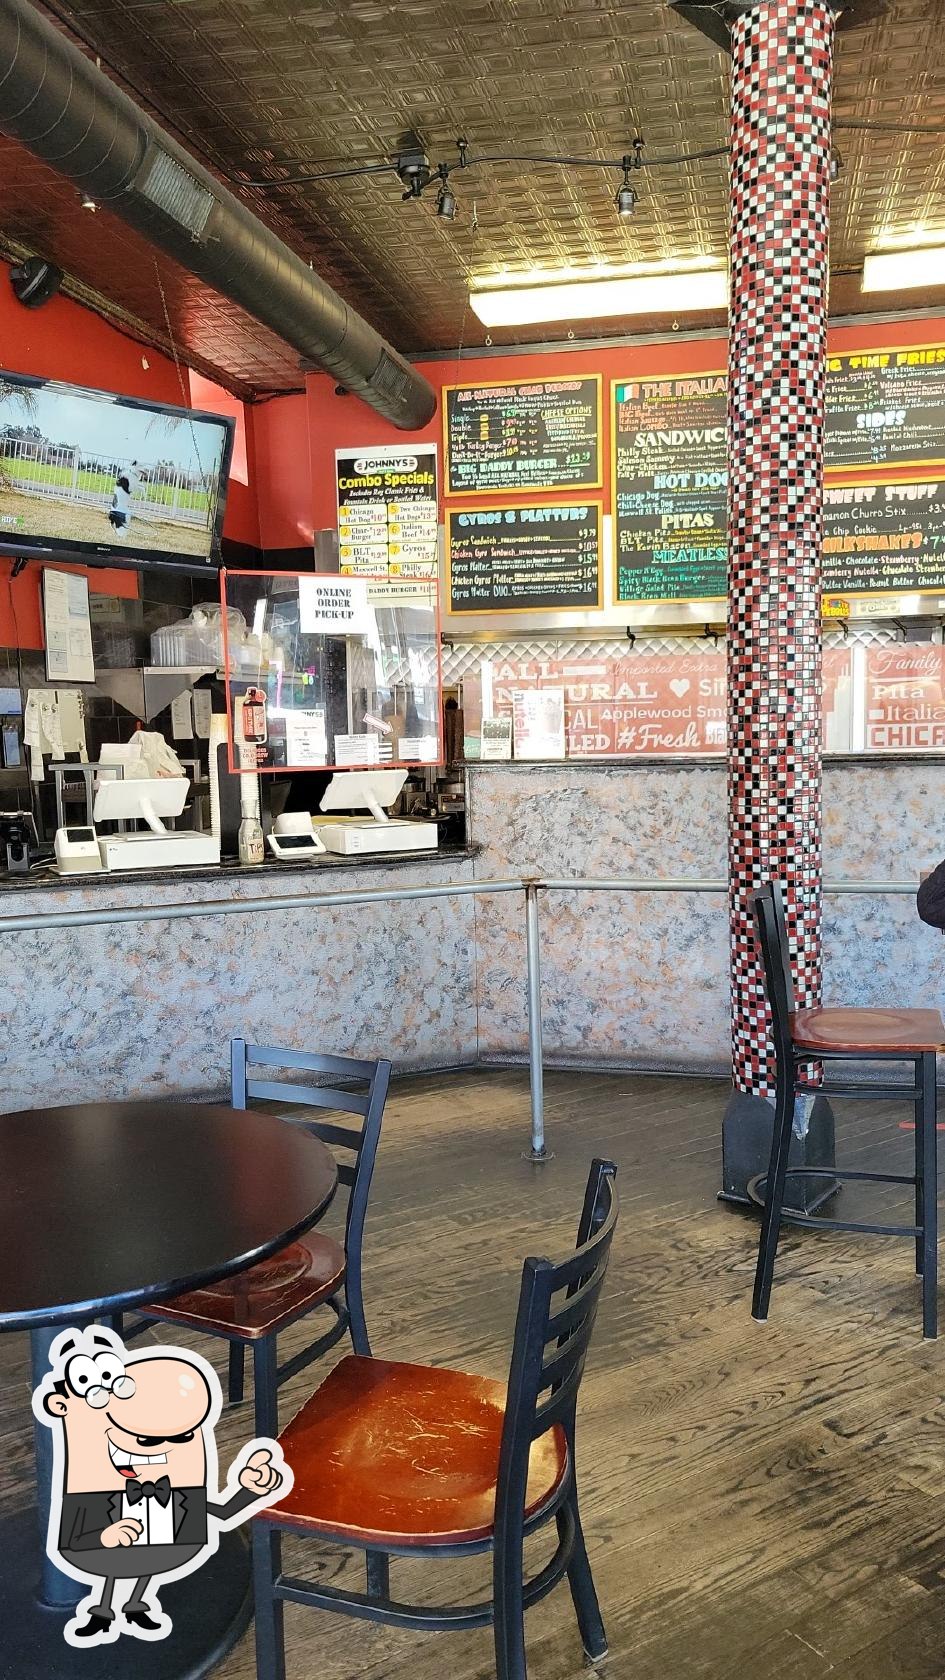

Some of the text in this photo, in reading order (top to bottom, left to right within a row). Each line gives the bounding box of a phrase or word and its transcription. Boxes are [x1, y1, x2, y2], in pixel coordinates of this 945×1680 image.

[849, 354, 890, 369] TIME
[896, 349, 945, 366] FRIES
[642, 376, 728, 398] THE ITALIA
[541, 408, 564, 418] CHEESE
[565, 406, 592, 414] OPTIONS
[856, 410, 906, 429] SIDES
[634, 428, 728, 448] SANDWIC
[618, 448, 640, 458] Philly
[458, 459, 557, 474] BIG DADDY BURGER
[339, 472, 434, 489] Combo Specials
[654, 474, 690, 489] HOT
[617, 492, 645, 503] Chicago
[646, 491, 660, 500] Dog
[885, 484, 938, 501] STUFF
[660, 500, 674, 508] Dog
[350, 508, 374, 516] Chicago
[851, 506, 907, 519] Churro Stix
[459, 512, 501, 526] GYROS
[505, 511, 516, 523] &
[661, 513, 714, 529] PITAS
[620, 530, 652, 538] Chicken
[833, 524, 877, 536] Chip Cookie
[451, 537, 470, 549] Gyros
[470, 536, 496, 545] Sandwich
[636, 543, 660, 551] Kevin
[353, 547, 371, 556] BLT
[402, 544, 426, 555] Gyros
[452, 550, 472, 559] Chicken
[491, 547, 515, 556] Sandwich
[846, 555, 919, 566] Chocolate Strawberry
[402, 564, 421, 572] Philly
[452, 562, 468, 574] Gyros
[854, 564, 913, 576] Nutella Chocolate
[452, 576, 473, 586] Chicken
[474, 574, 491, 586] Gyros
[843, 580, 866, 588] Vanilla
[316, 588, 351, 598] ONLINE
[452, 588, 469, 600] Gyros
[494, 584, 508, 597] DUO
[318, 599, 350, 608] ORDER
[315, 610, 354, 619] PICK-UP
[868, 650, 941, 675] Family
[495, 662, 558, 680] ALL
[679, 659, 717, 674] Extra
[496, 682, 658, 703] NURAL
[601, 706, 691, 722] Applewood
[566, 721, 700, 751] LED #Fresh
